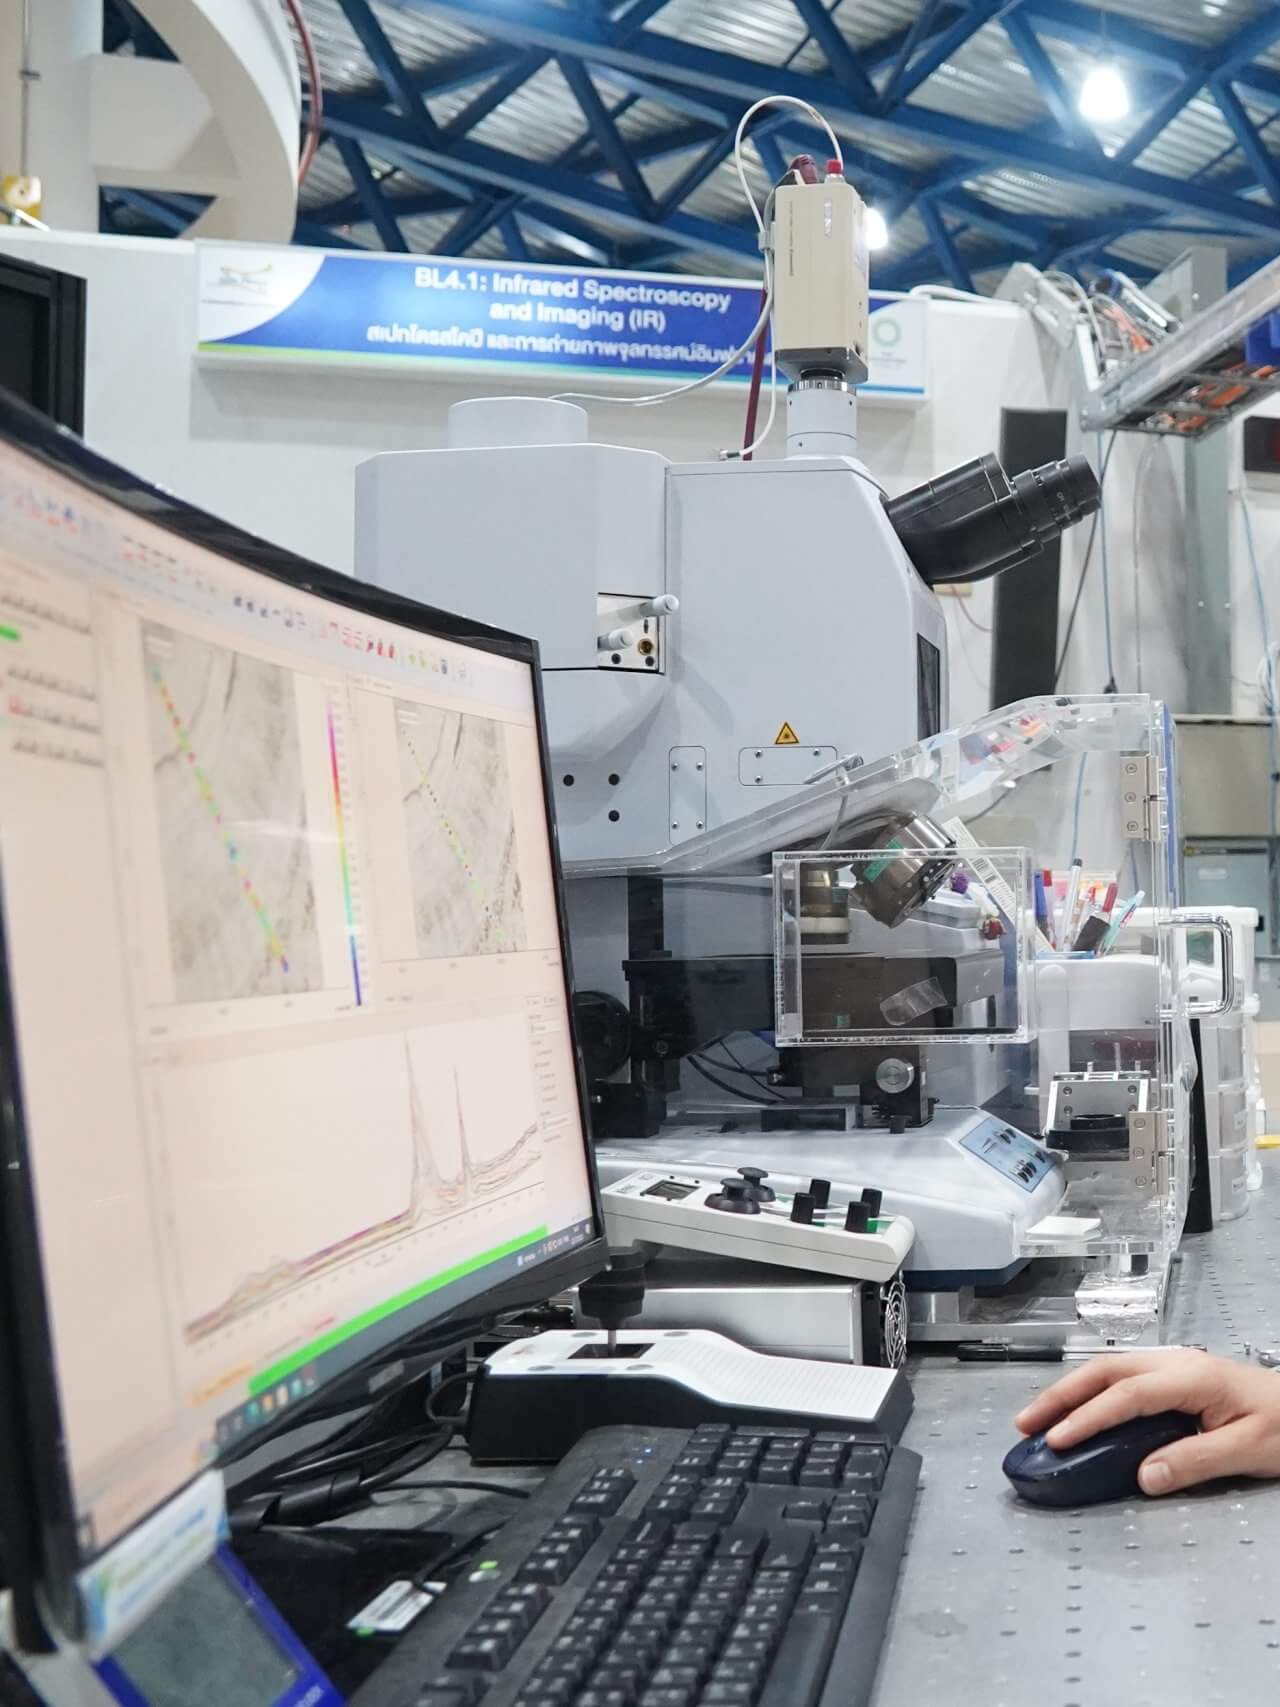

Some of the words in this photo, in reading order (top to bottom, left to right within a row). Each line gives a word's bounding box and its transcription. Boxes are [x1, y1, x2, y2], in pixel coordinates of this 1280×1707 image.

[414, 267, 488, 292] BL4.1:
[493, 273, 579, 298] Infrared
[583, 279, 732, 313] Spectroscopy
[489, 301, 533, 321] and
[537, 303, 624, 330] Imaging
[629, 310, 667, 333] (IR)
